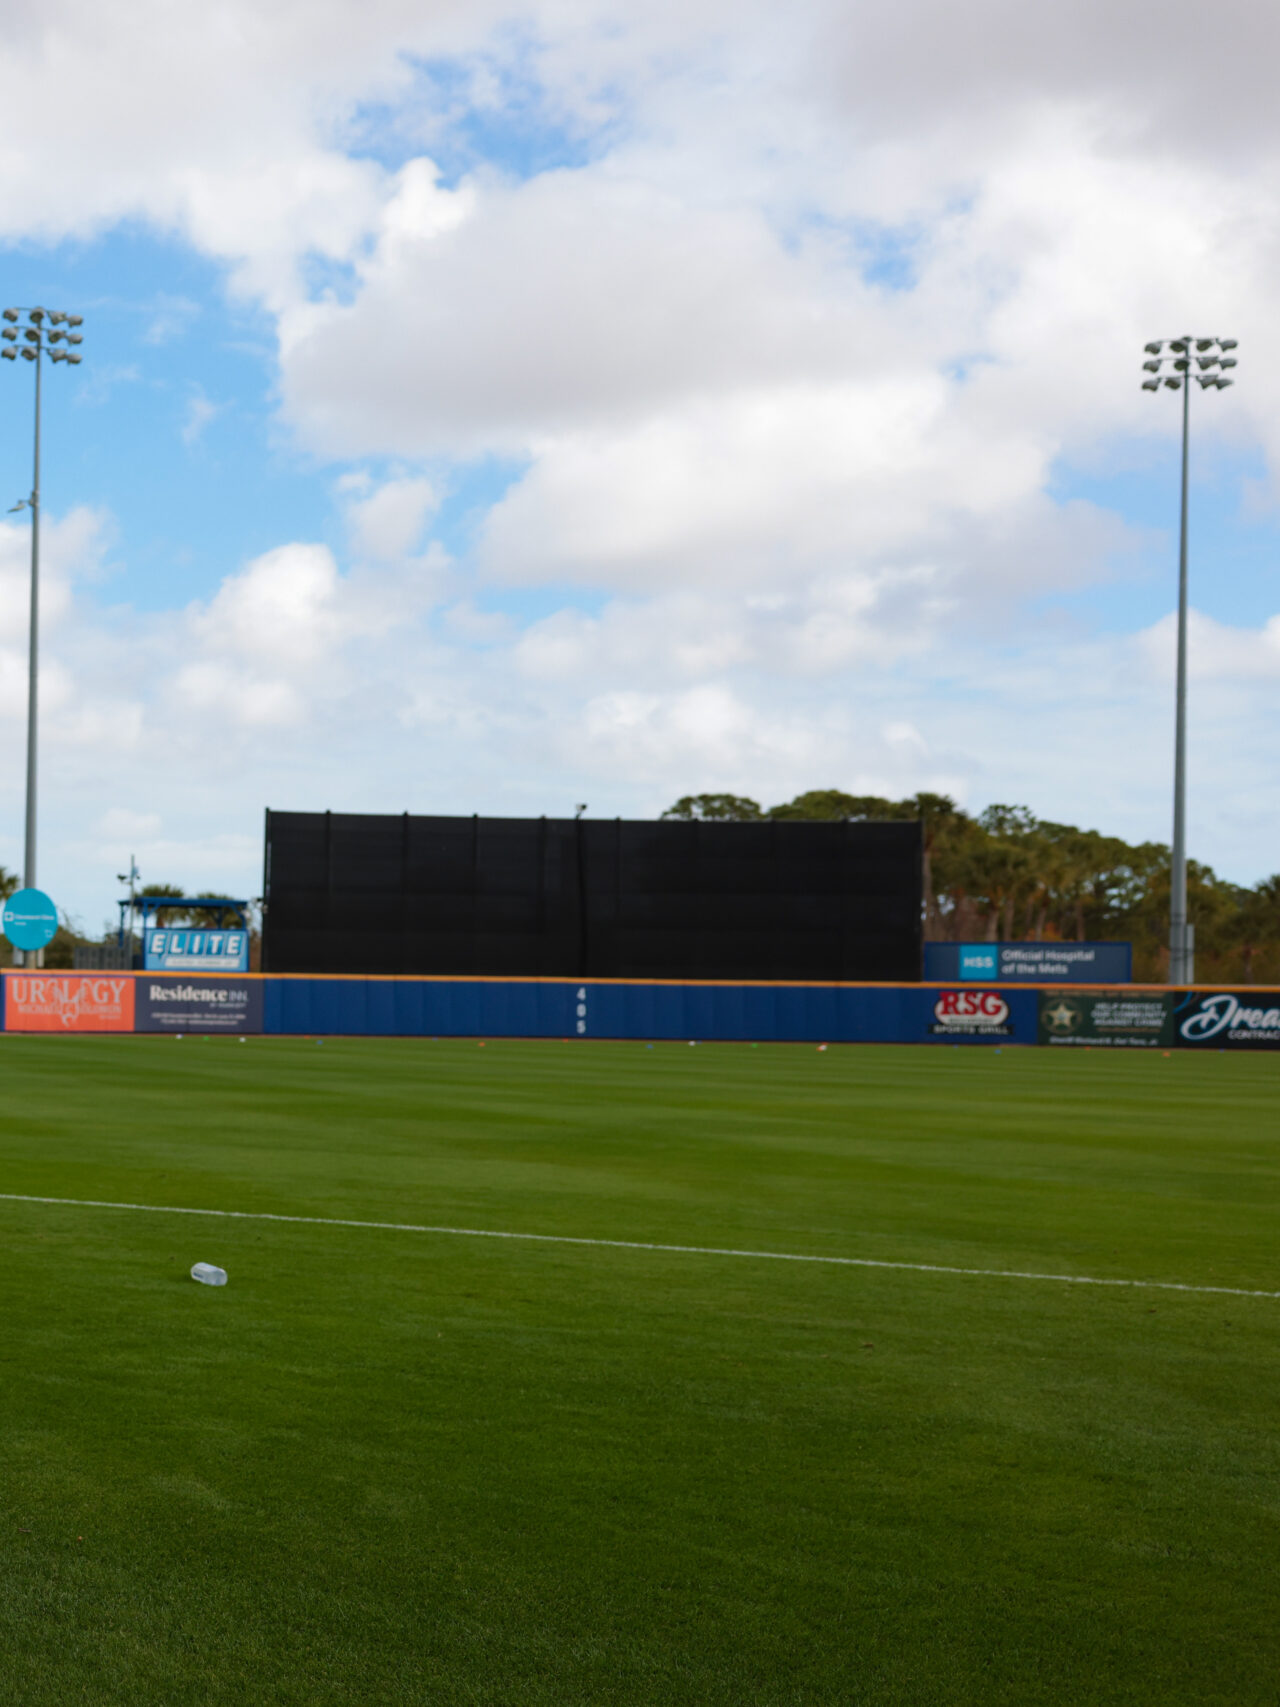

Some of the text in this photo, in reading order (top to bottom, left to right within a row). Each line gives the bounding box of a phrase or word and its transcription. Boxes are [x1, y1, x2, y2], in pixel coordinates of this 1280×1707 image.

[151, 933, 241, 955] ELITE
[963, 956, 994, 968] HSS
[1001, 949, 1095, 964] Official Hospital
[1001, 963, 1068, 974] of the Mets
[150, 985, 229, 1002] Residence
[939, 990, 1003, 1016] RSG
